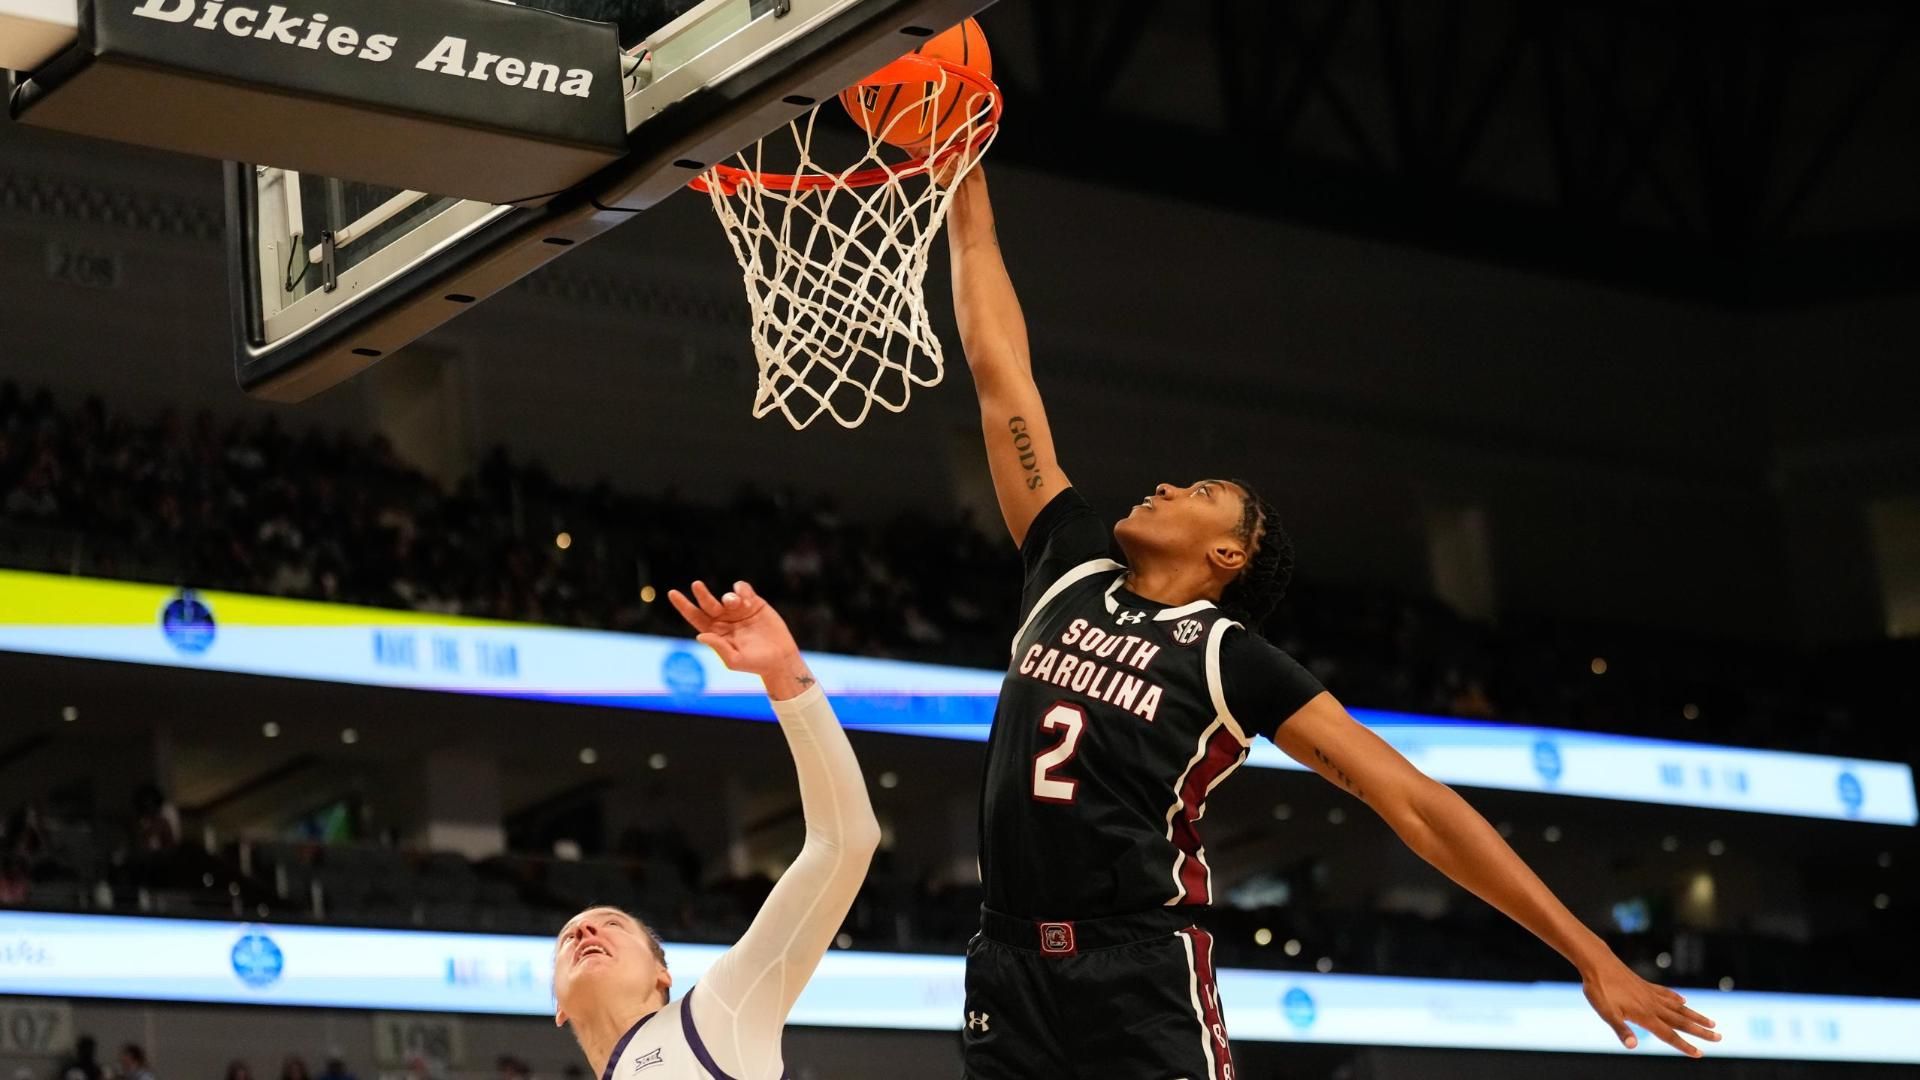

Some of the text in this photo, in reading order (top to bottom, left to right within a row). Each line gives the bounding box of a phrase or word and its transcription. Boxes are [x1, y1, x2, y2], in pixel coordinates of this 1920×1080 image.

[132, 0, 595, 98] Dickies Arena
[1008, 415, 1044, 491] GOD'S
[1061, 617, 1161, 671] SOUTH
[1172, 618, 1203, 644] SEC
[1018, 642, 1165, 723] CAROLINA
[1031, 702, 1086, 804] 2
